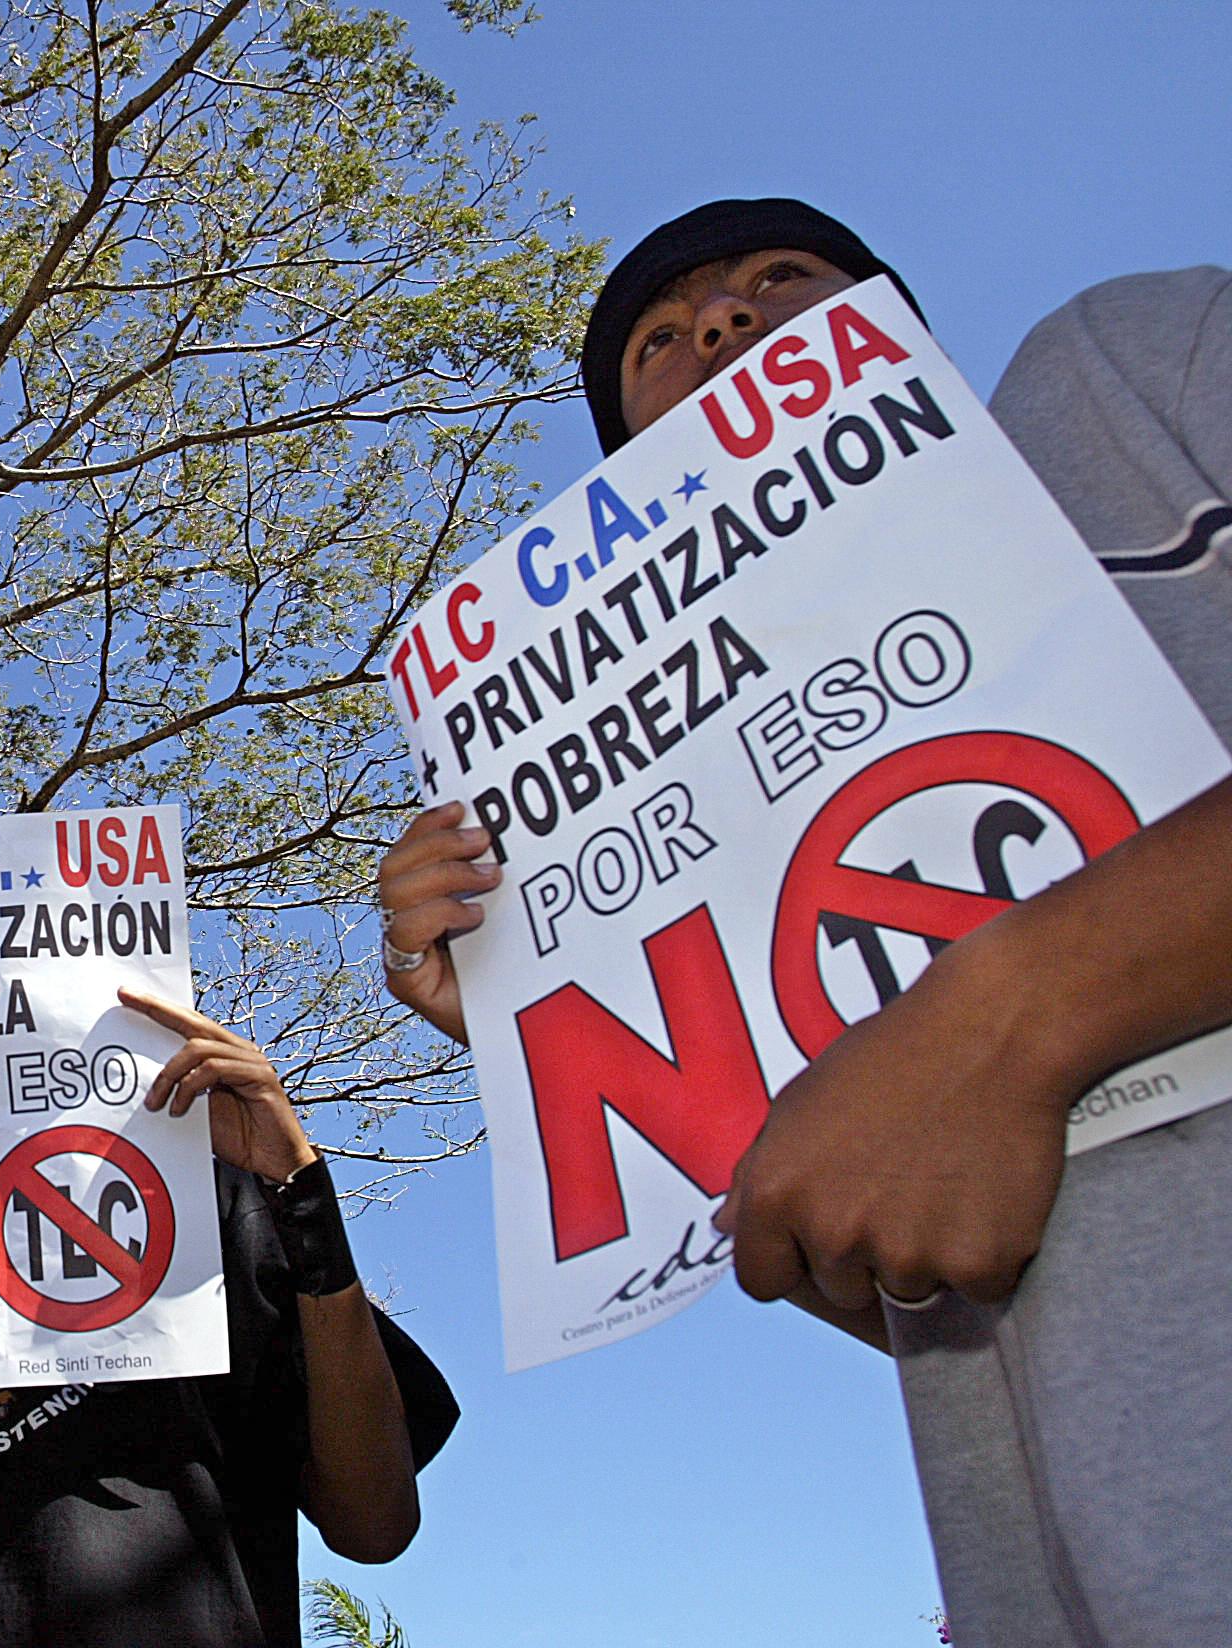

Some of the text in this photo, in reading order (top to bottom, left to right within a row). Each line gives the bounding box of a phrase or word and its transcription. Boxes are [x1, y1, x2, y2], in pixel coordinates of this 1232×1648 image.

[390, 302, 911, 722] TLC C.A. USA
[444, 376, 956, 775] PRIVATIZACIÓN
[472, 615, 770, 866] POBREZA
[520, 608, 972, 957] POR ESO
[56, 815, 172, 888] USA
[6, 1044, 139, 1115] ESO
[1066, 1072, 1179, 1125] echan
[19, 1359, 50, 1375] Red
[94, 1354, 153, 1370] Techan
